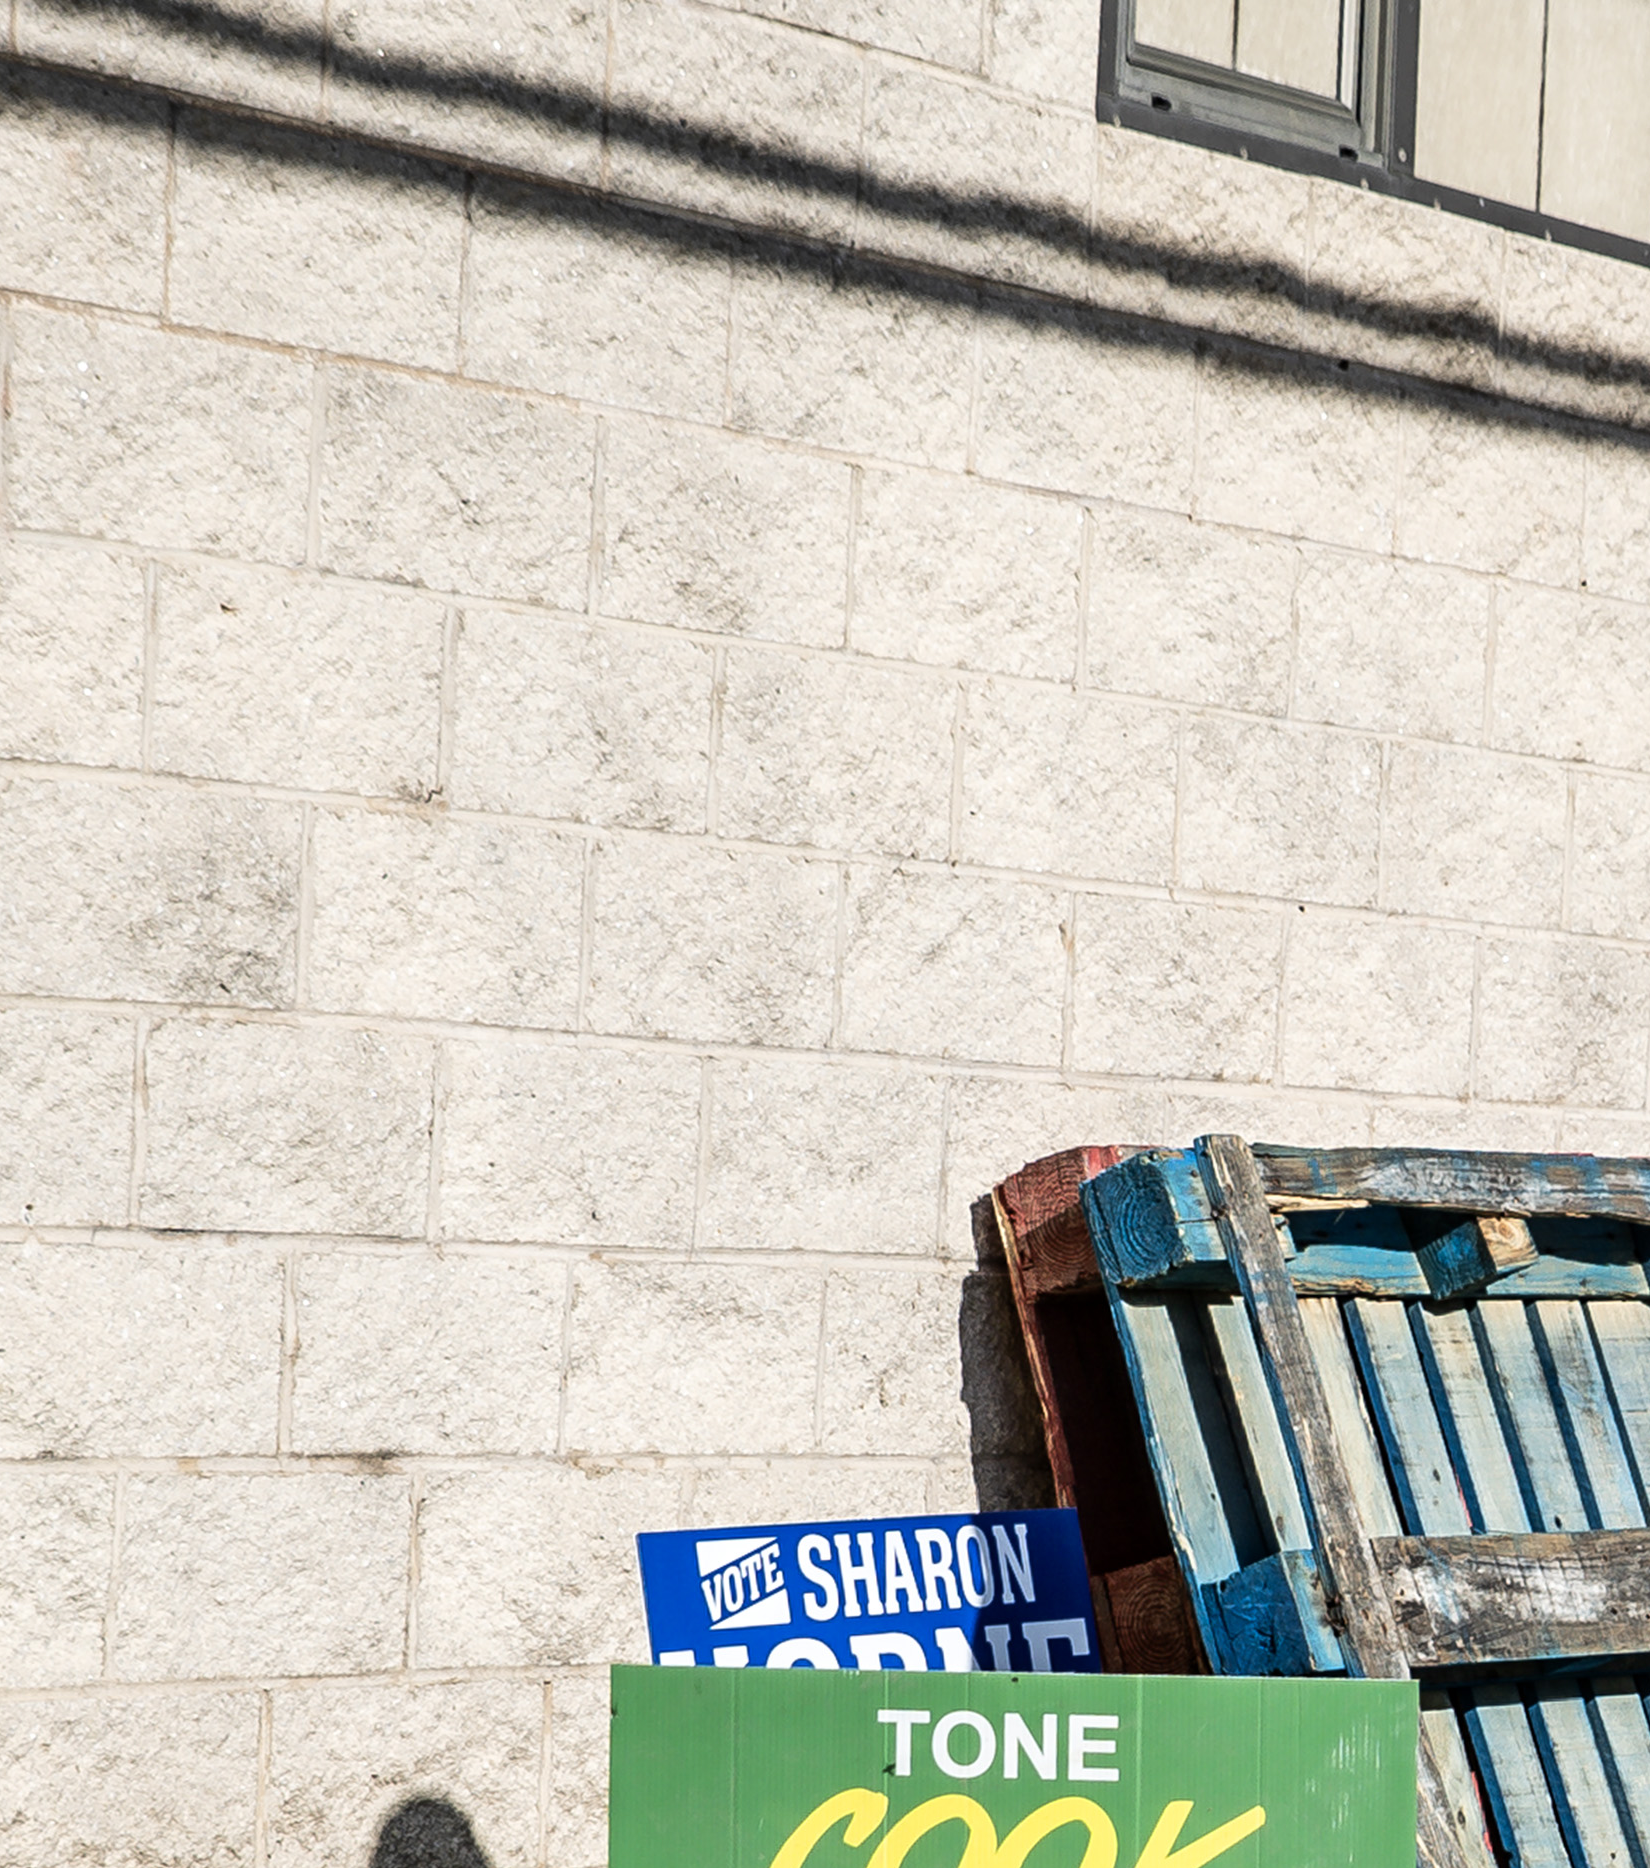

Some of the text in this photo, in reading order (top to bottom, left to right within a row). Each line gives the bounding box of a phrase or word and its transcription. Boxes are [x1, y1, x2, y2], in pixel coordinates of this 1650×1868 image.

[700, 1523, 1036, 1624] VOTE SHARON
[877, 1708, 1120, 1782] TONE
